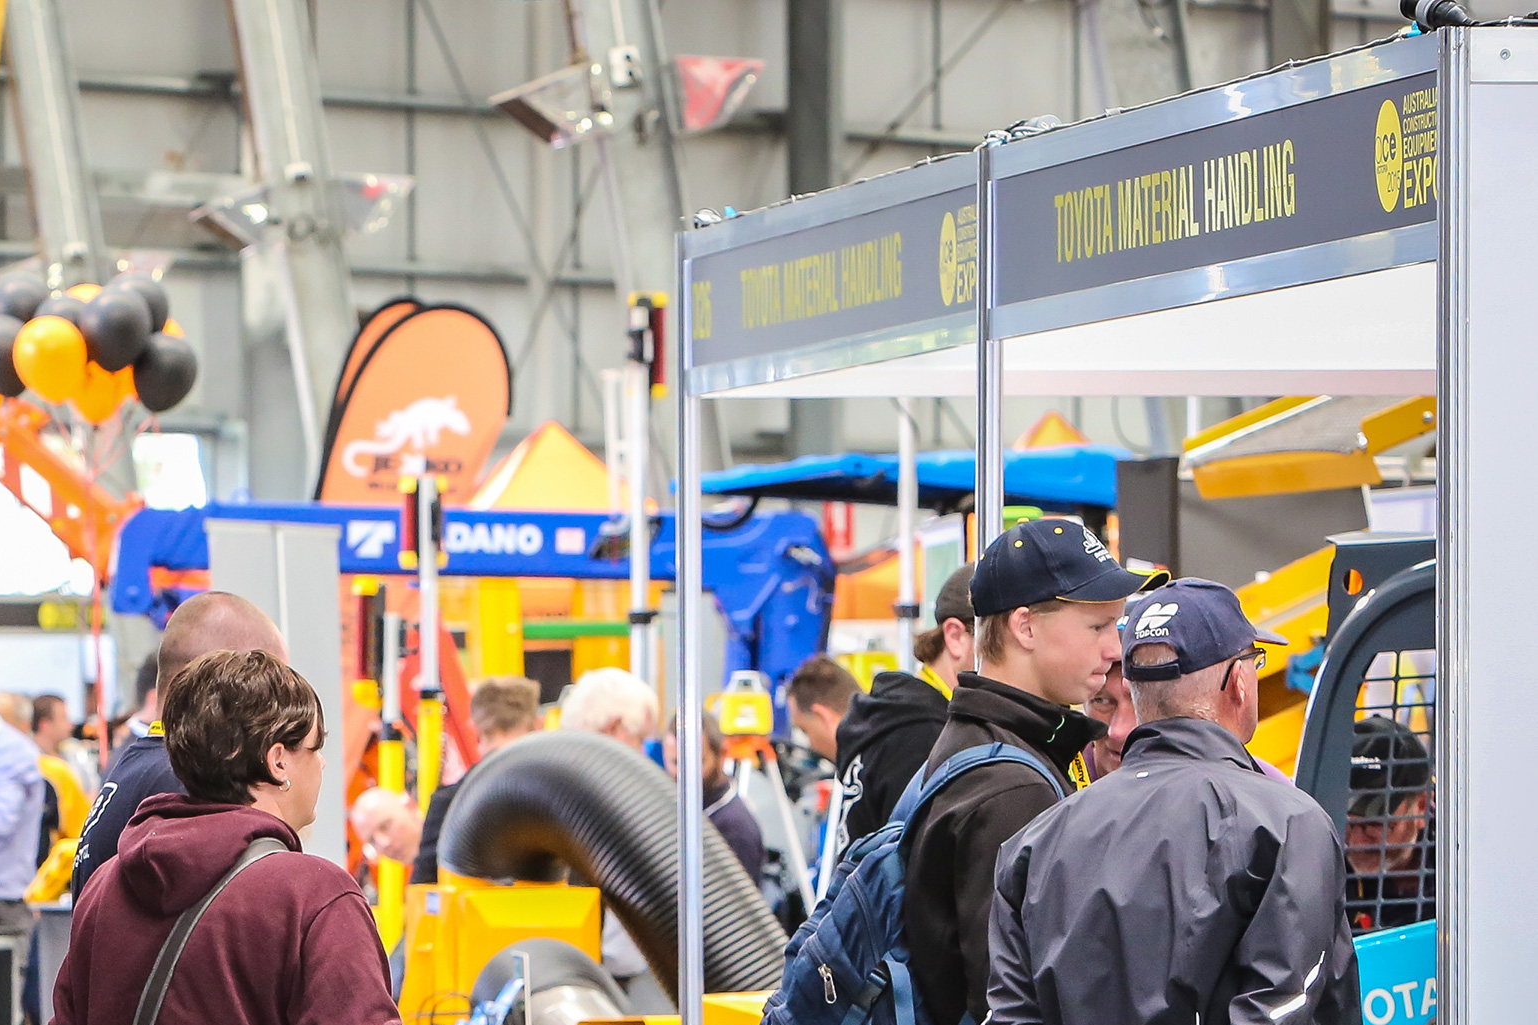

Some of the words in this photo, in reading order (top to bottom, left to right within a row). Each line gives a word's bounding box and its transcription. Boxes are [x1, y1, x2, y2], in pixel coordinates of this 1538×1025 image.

[1403, 87, 1438, 115] AUSTRALI
[1403, 111, 1438, 134] CONSTRUCTI
[1403, 130, 1438, 159] EQUIPME
[1054, 184, 1113, 262] TOYOTA
[1117, 164, 1200, 250] MATERIAL
[1203, 139, 1296, 234] HANDLING
[740, 265, 782, 328] TOYOTA
[783, 252, 839, 321] MATERIAL
[841, 232, 902, 309] HANDLING
[957, 261, 977, 303] EXP
[446, 521, 544, 556] DANO
[1134, 627, 1170, 640] TOPCON
